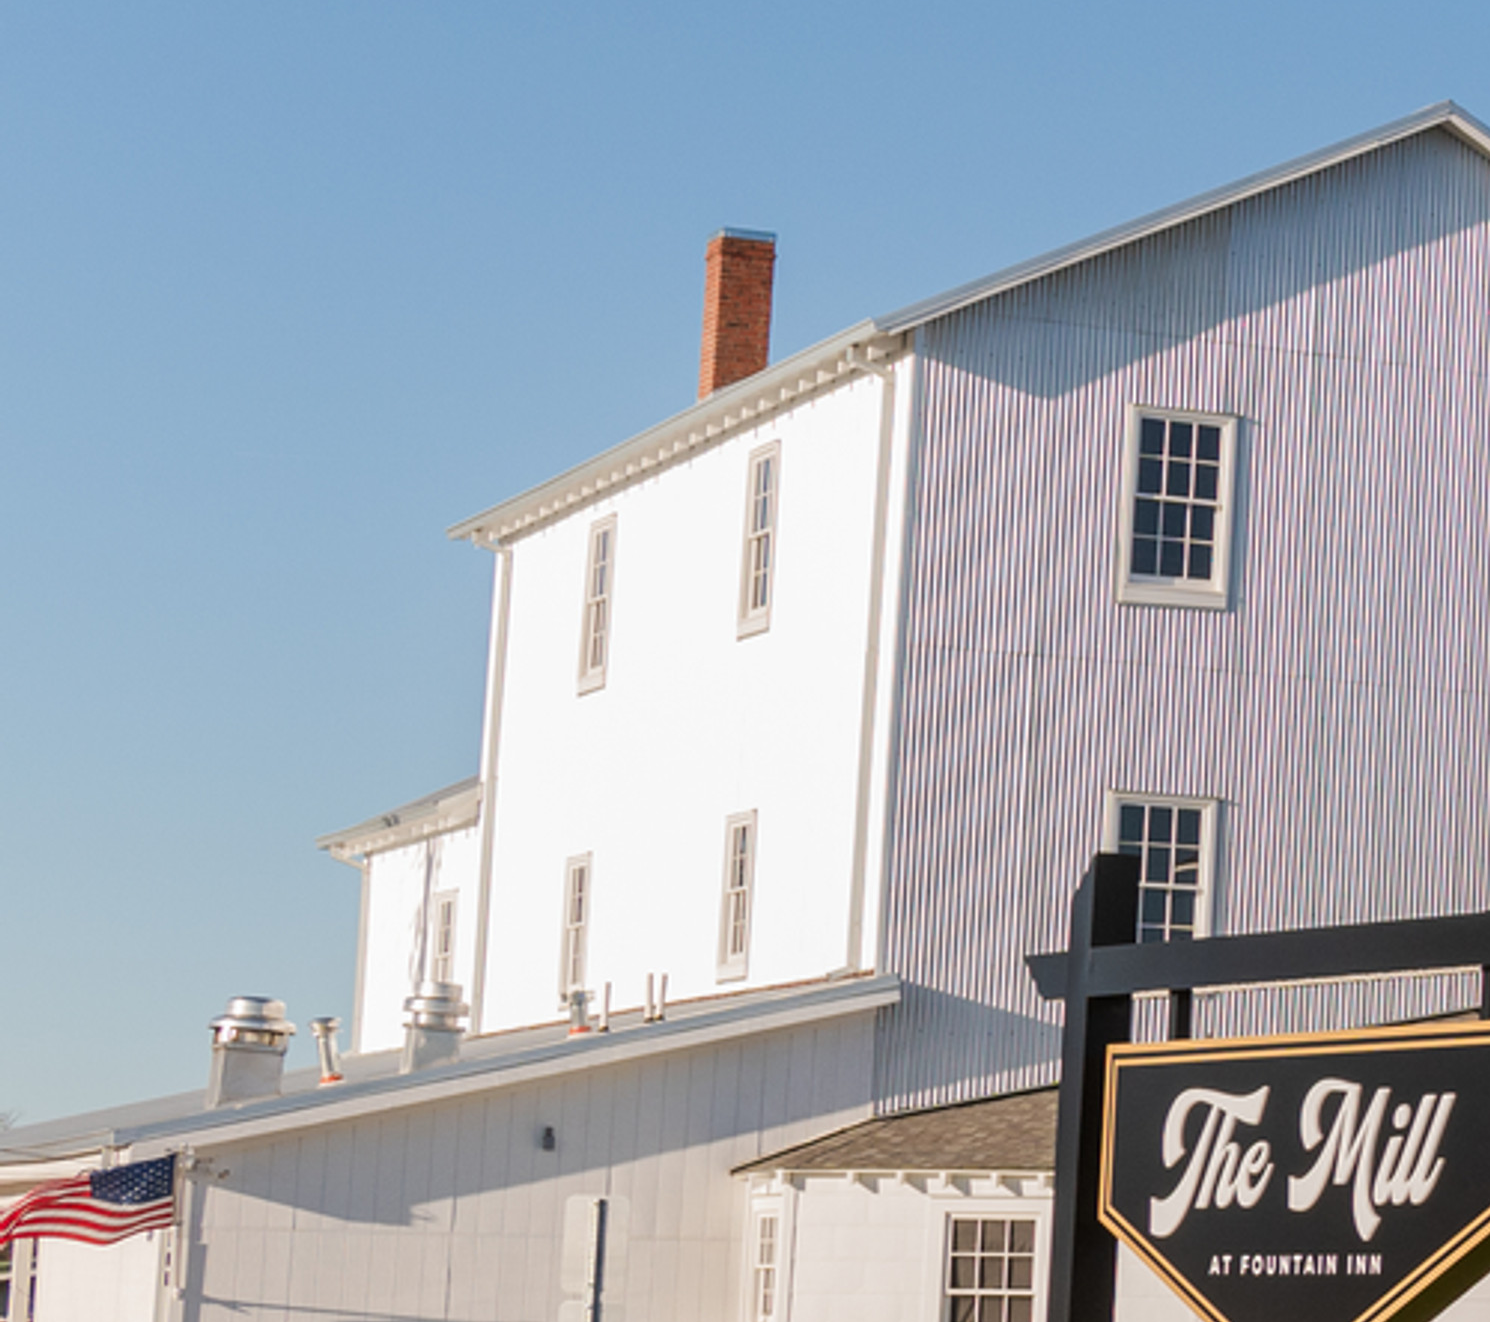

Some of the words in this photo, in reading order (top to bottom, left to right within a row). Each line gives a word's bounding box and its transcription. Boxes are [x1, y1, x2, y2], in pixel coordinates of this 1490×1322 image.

[1149, 1085, 1274, 1239] The
[1286, 1078, 1457, 1242] Mill
[1208, 1254, 1233, 1276] AT
[1240, 1254, 1337, 1276] FOUNTAIN
[1346, 1253, 1382, 1276] INN
